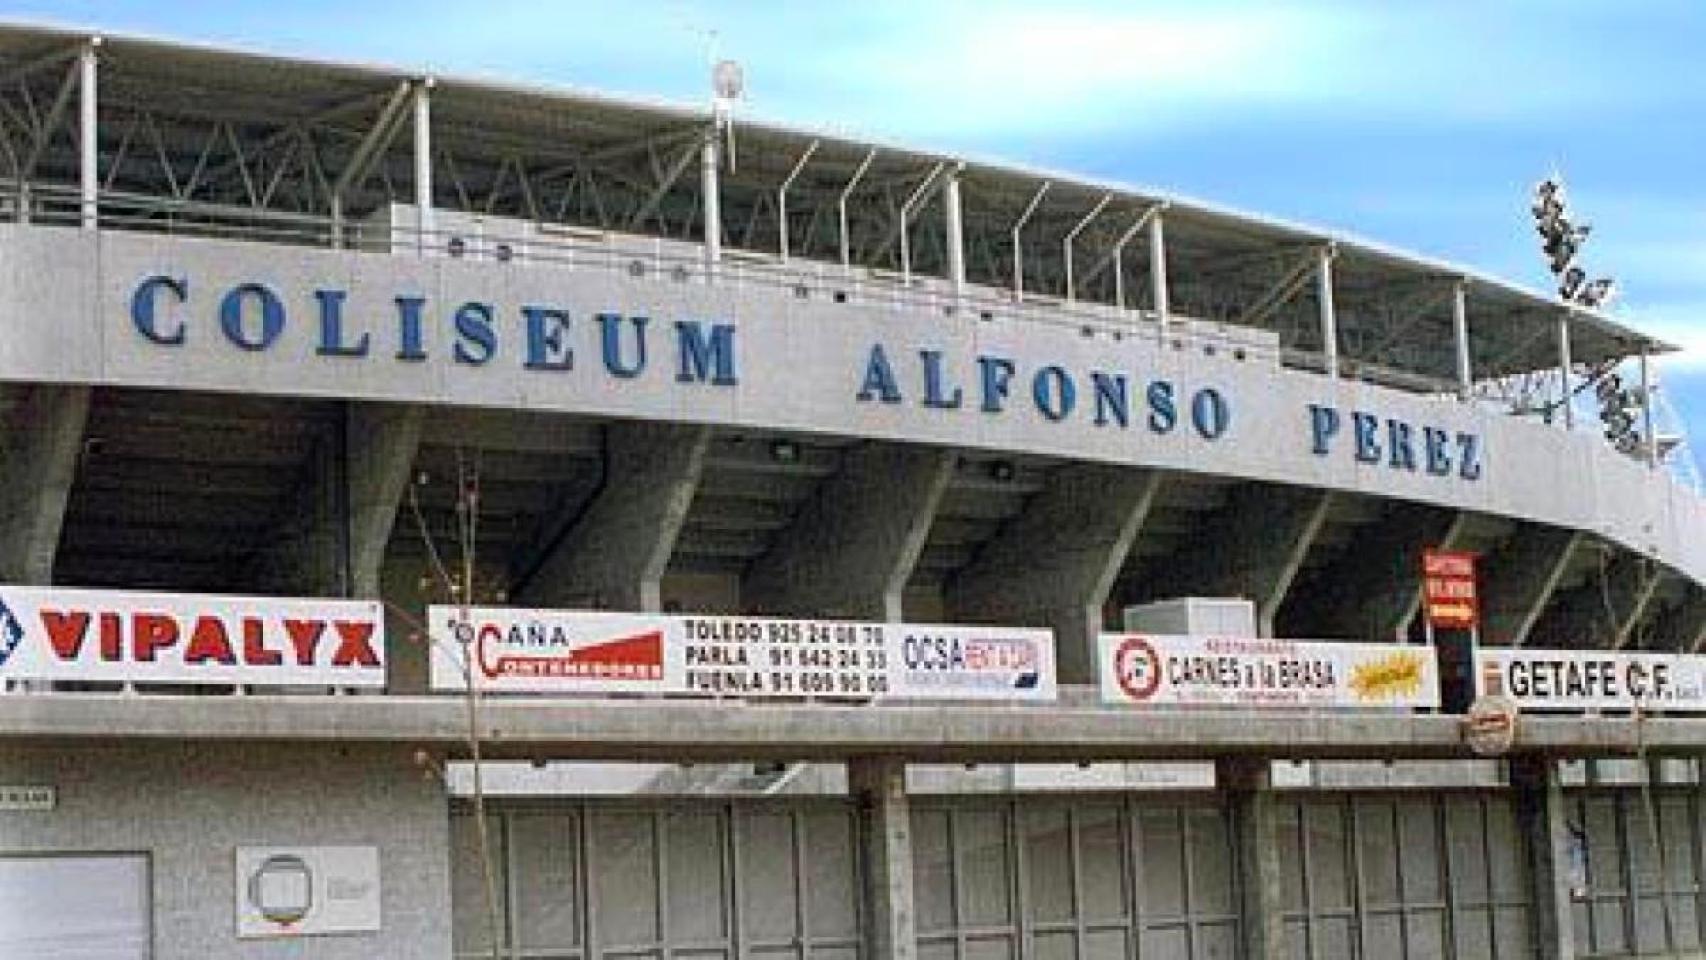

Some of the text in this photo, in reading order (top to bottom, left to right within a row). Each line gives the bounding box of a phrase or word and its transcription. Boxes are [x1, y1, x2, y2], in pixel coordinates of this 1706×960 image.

[131, 275, 1482, 480] COLISEUM ALFONSO PEREZ
[39, 608, 381, 667] VIPALYX
[685, 619, 763, 643] TOLEDO
[768, 623, 800, 644] 925
[685, 645, 749, 666] PARLA
[769, 648, 793, 667] 91
[904, 634, 966, 670] OCSA
[685, 671, 763, 692] FUENLA
[770, 671, 793, 692] 91
[1168, 656, 1241, 688] CARNES
[1278, 660, 1338, 690] BRASA
[1509, 661, 1619, 697] GETAFE
